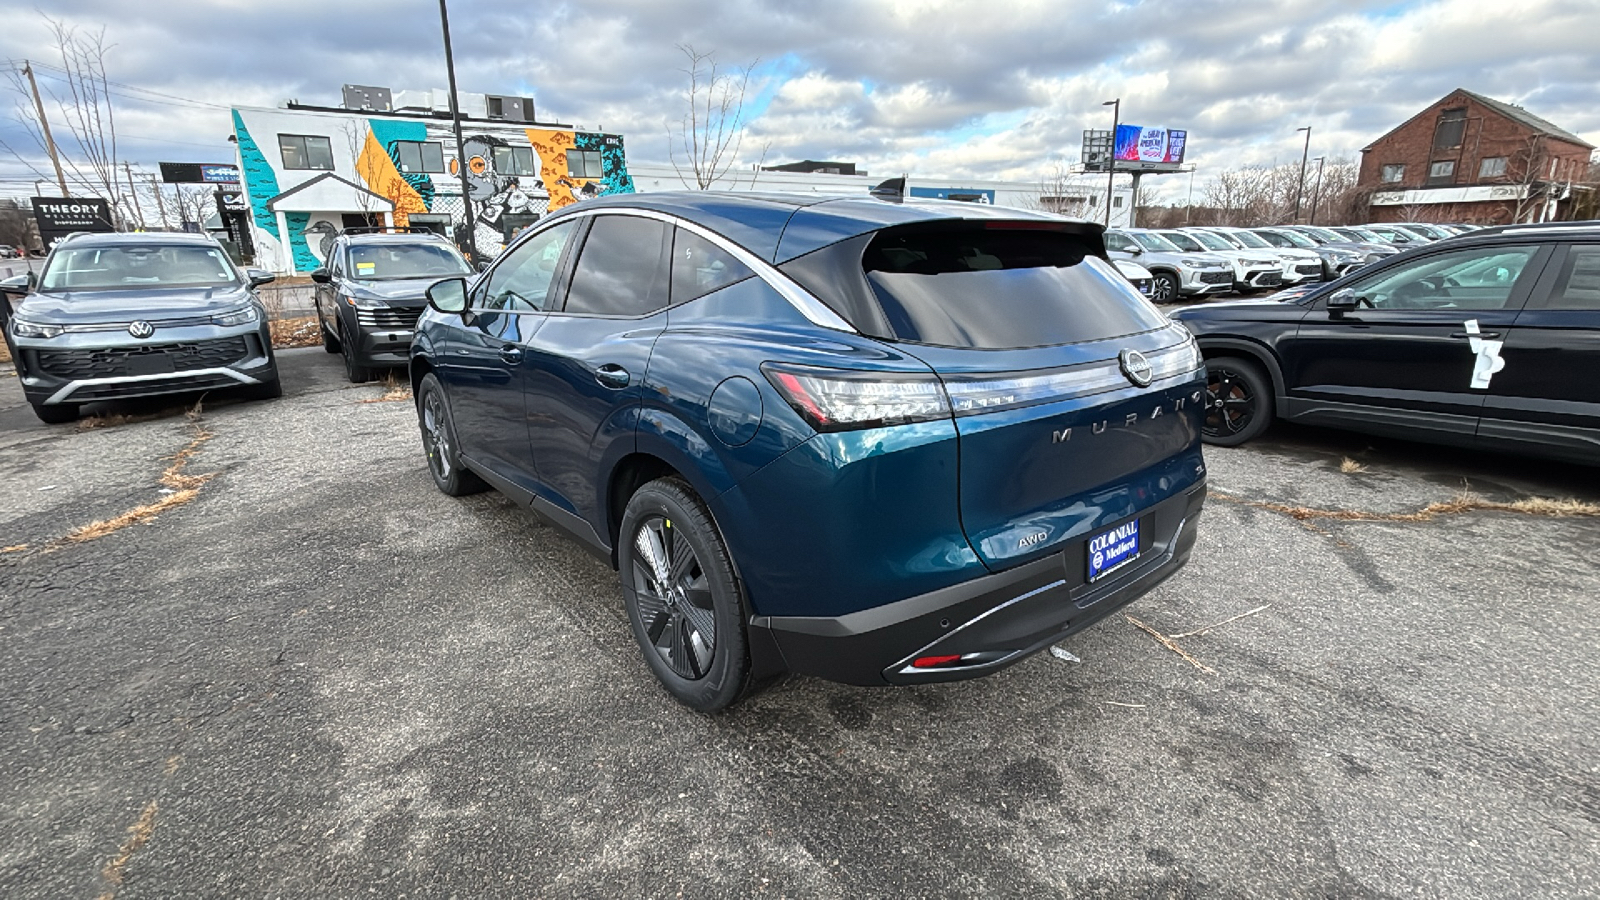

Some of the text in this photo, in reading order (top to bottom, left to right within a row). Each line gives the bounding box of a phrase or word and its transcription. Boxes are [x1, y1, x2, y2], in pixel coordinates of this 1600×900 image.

[39, 204, 99, 214] THEORY
[1052, 391, 1200, 444] MURANO
[1018, 531, 1048, 549] AWD
[1090, 521, 1138, 553] COLONIAL
[1106, 537, 1136, 561] Medford
